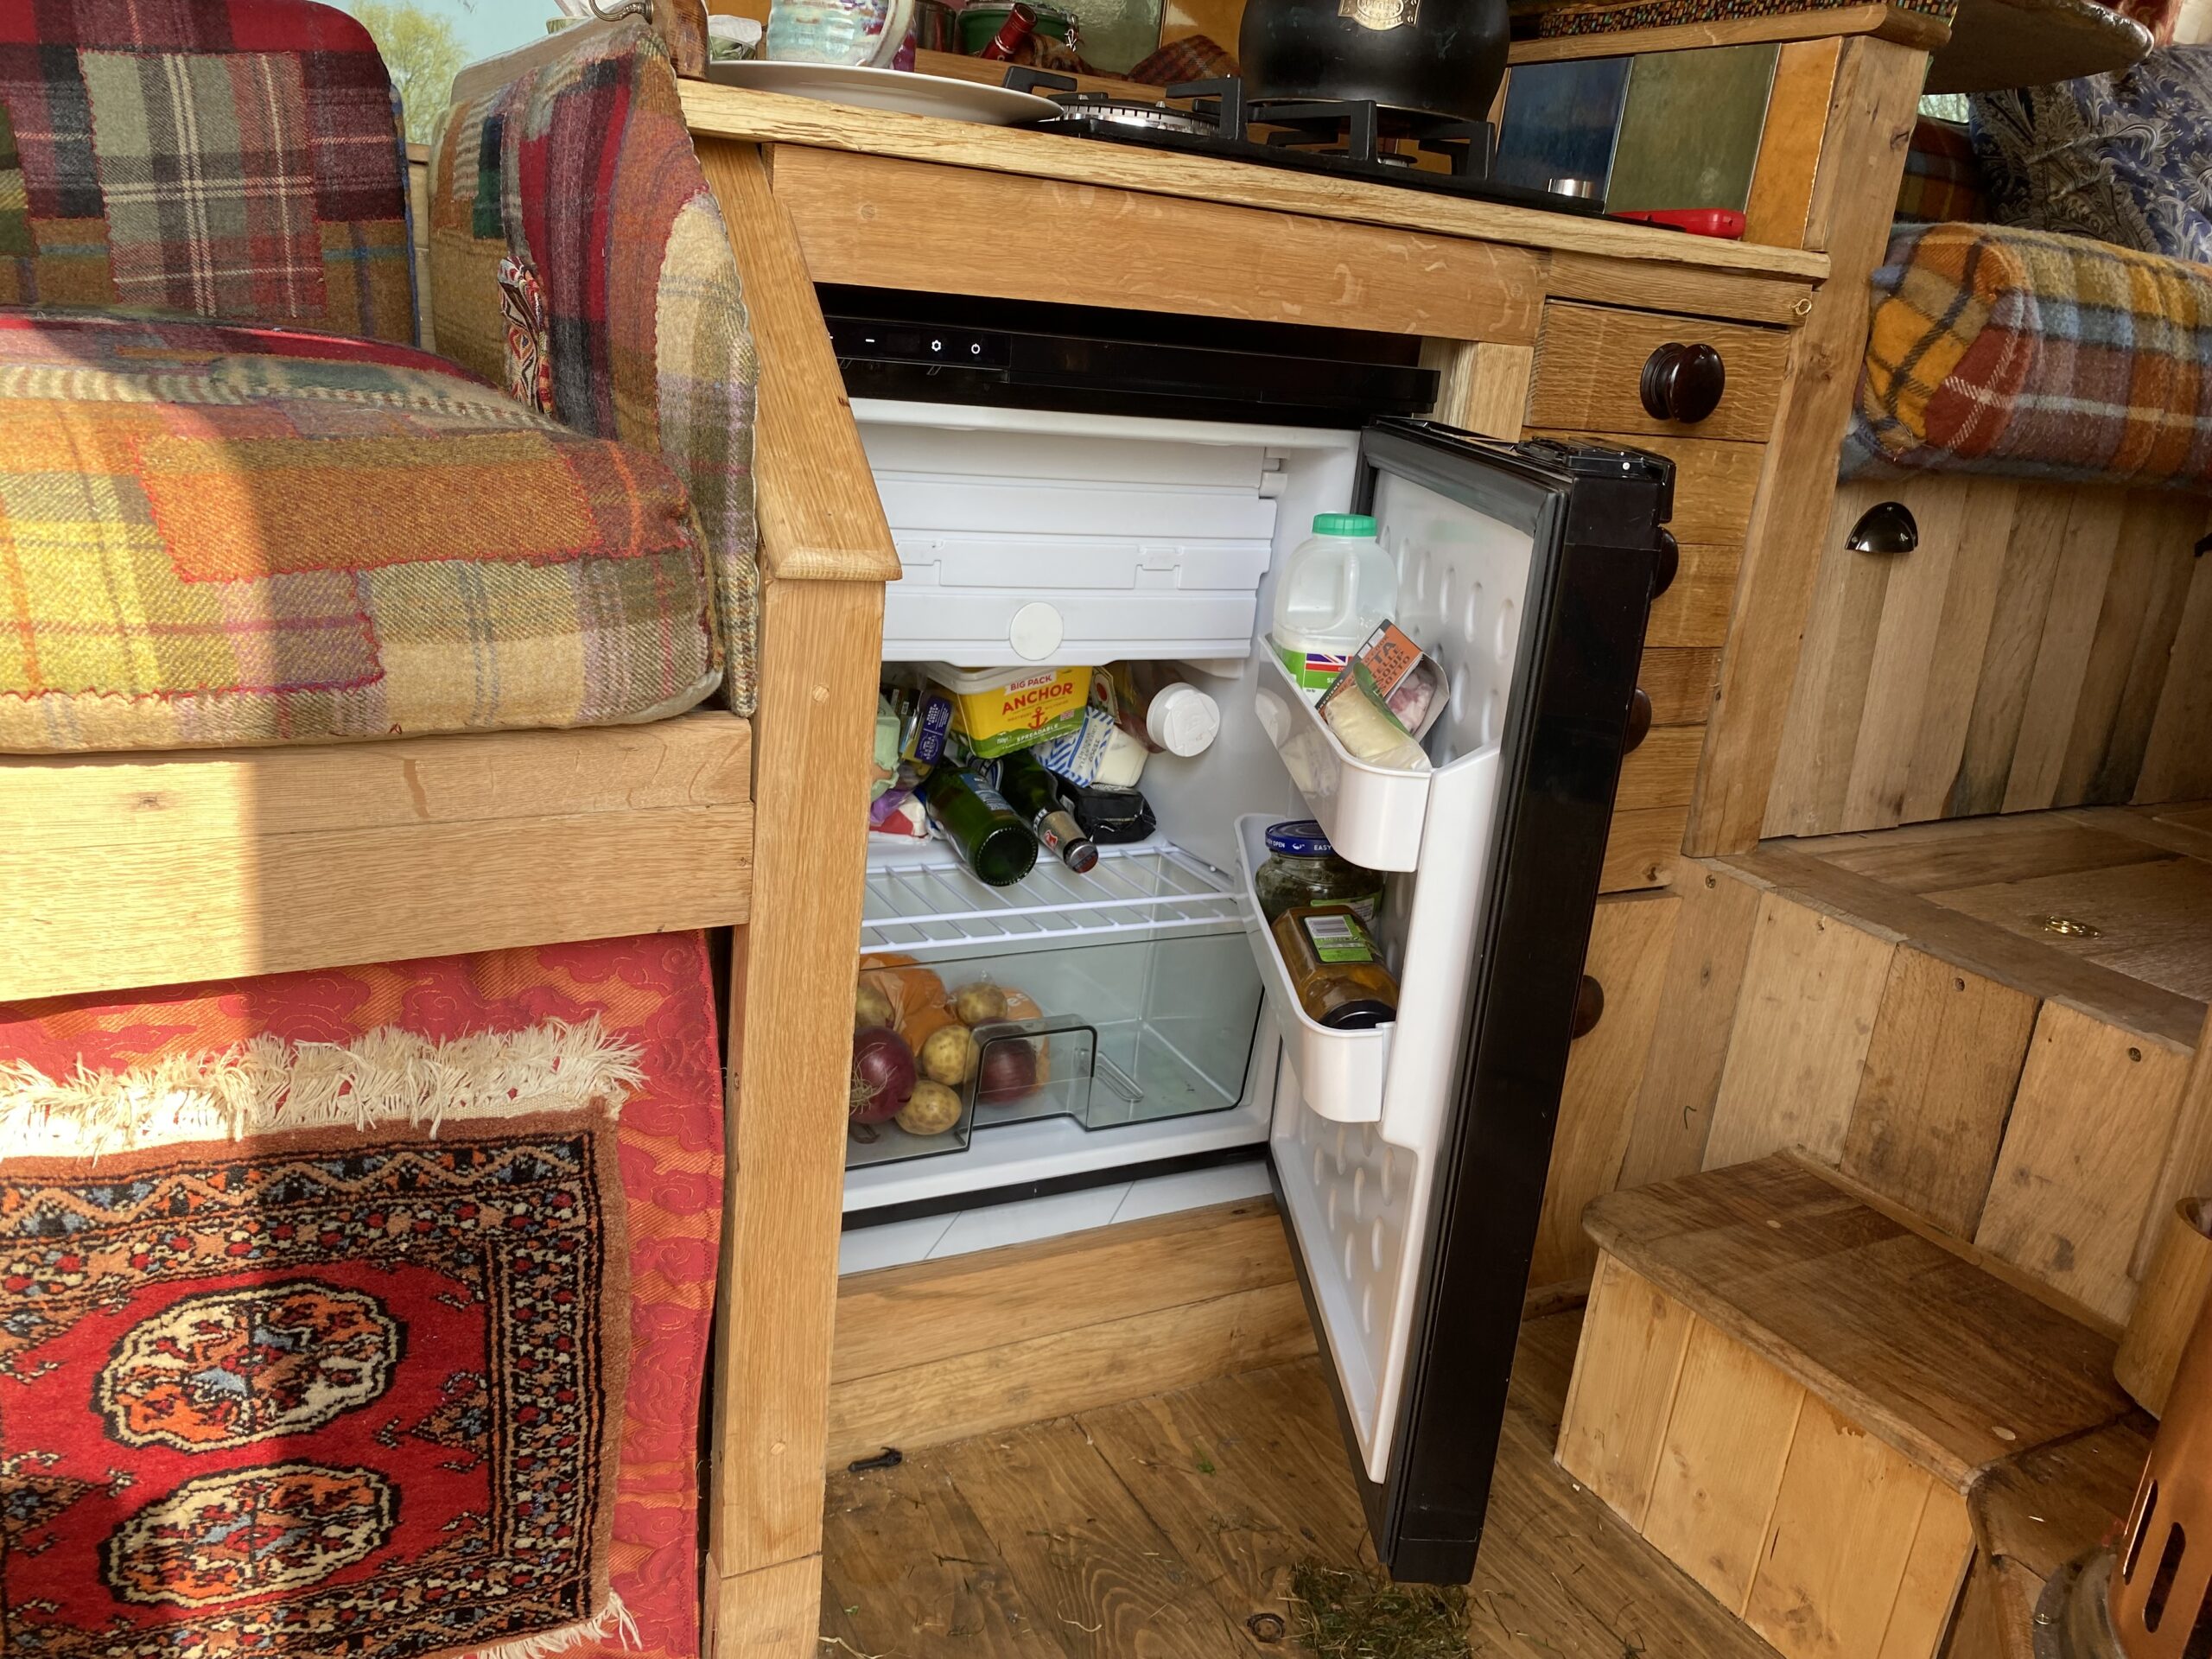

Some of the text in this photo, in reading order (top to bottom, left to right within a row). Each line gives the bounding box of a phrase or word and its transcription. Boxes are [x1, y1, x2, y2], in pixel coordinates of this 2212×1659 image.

[1010, 674, 1052, 691] BIG PACK
[1001, 682, 1074, 716] ANCHOR
[1016, 723, 1058, 742] SPREADABLE
[1273, 840, 1286, 849] OPEN
